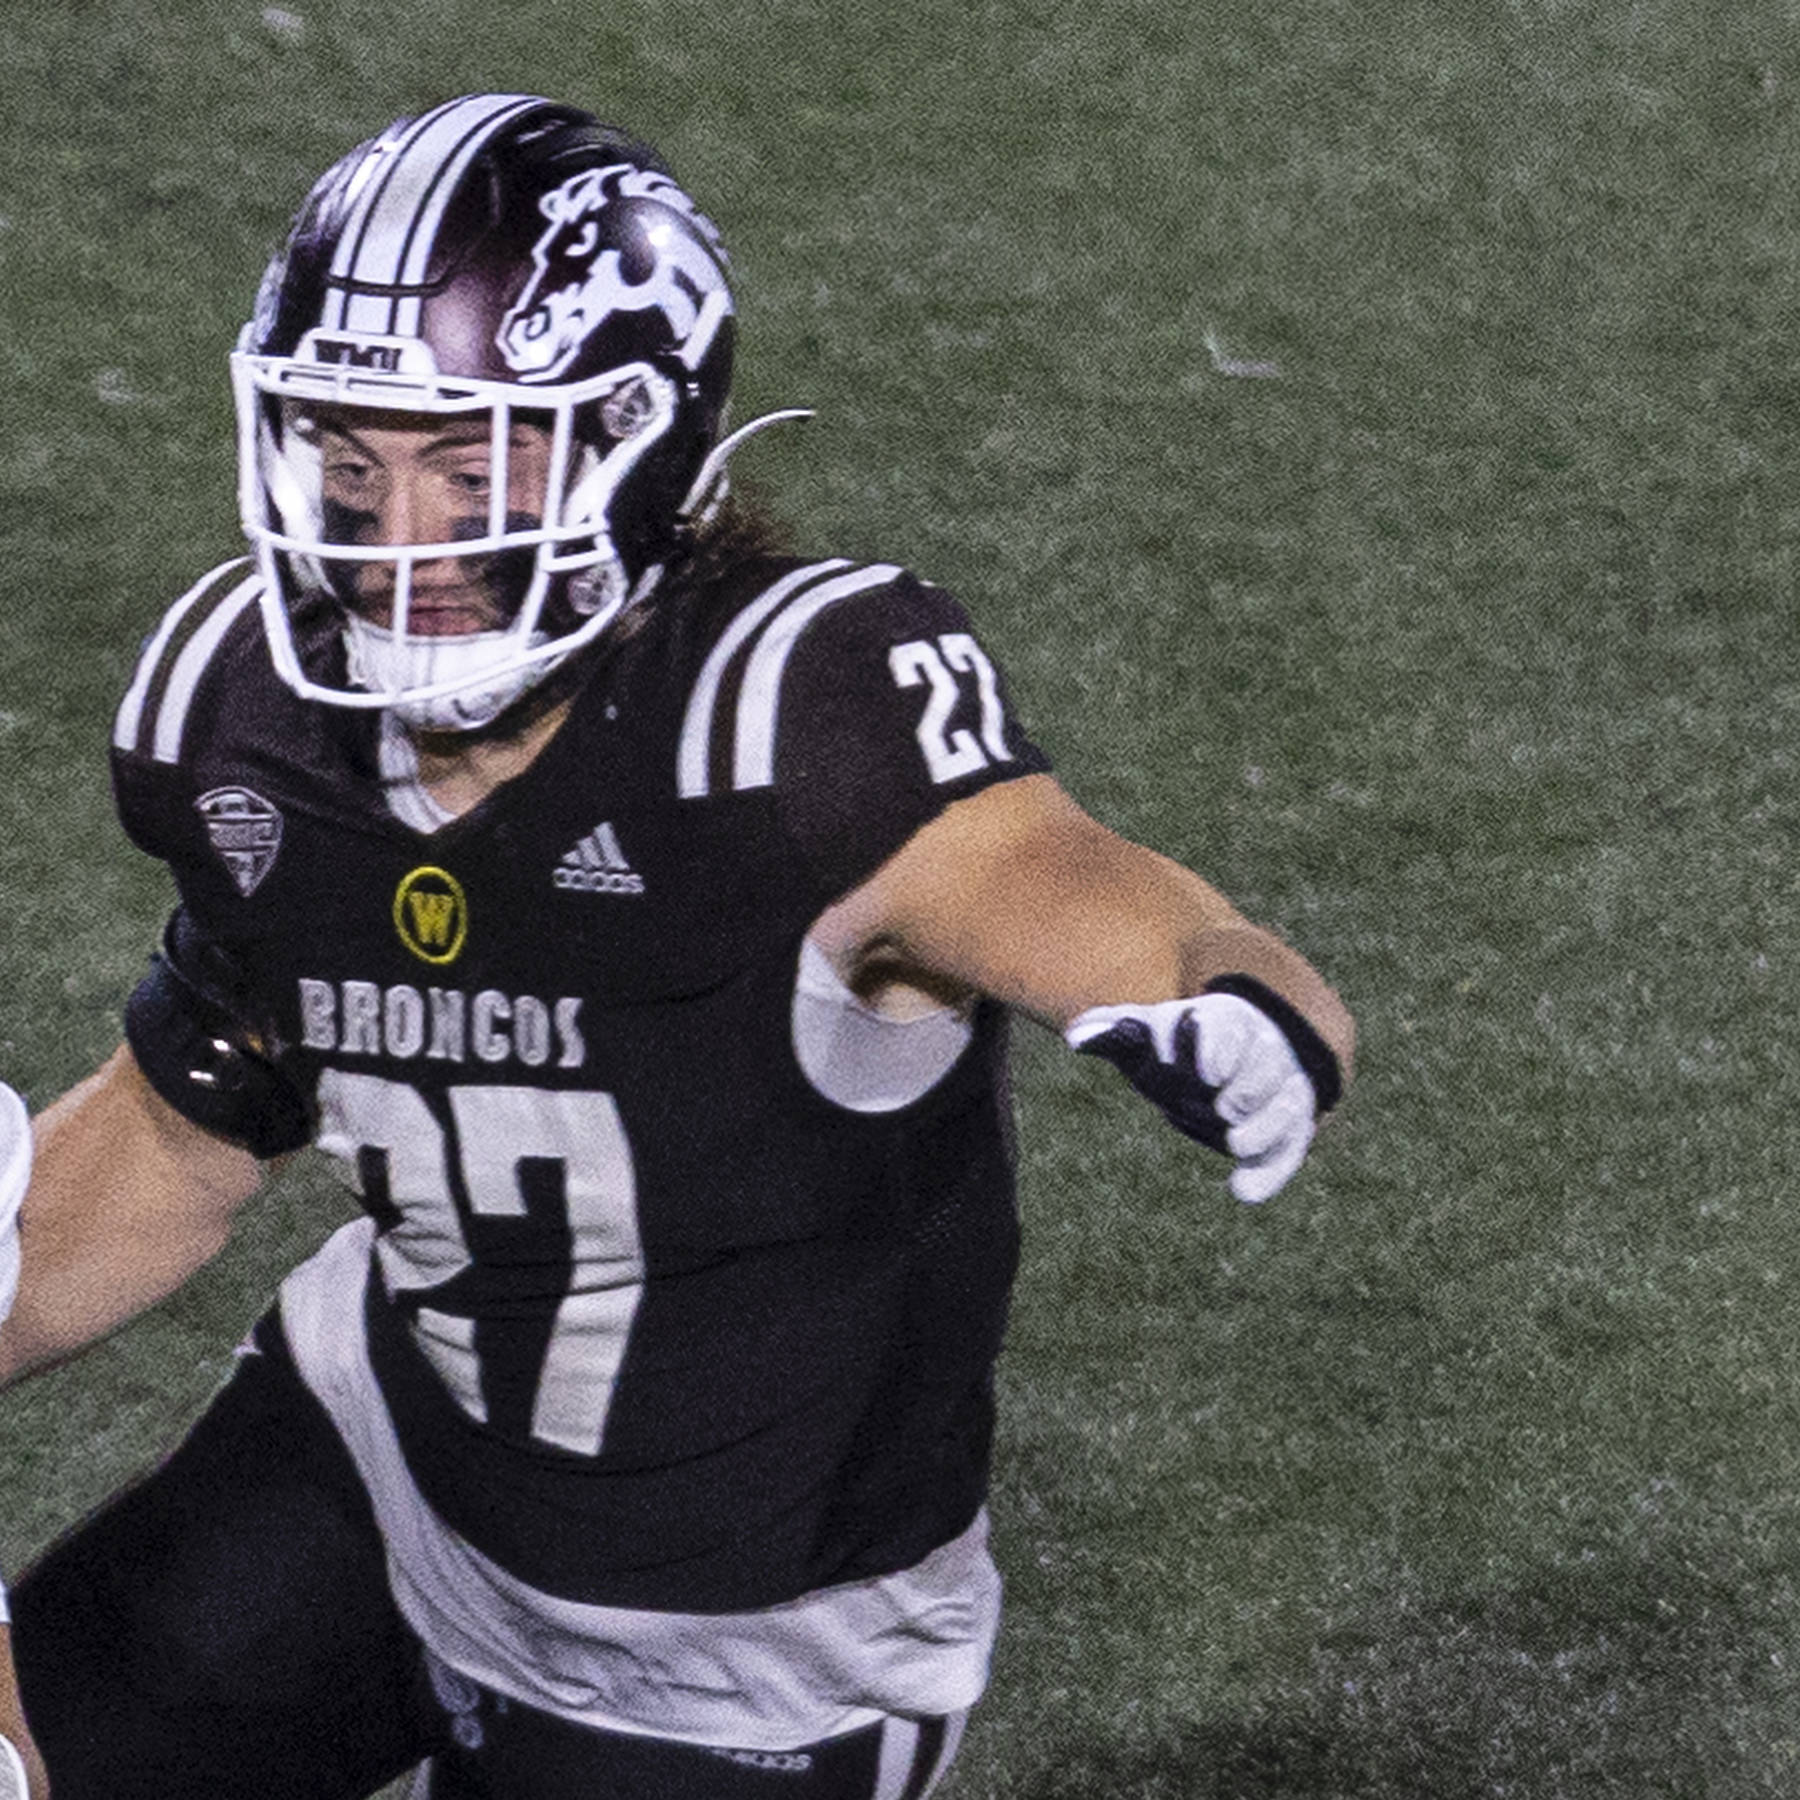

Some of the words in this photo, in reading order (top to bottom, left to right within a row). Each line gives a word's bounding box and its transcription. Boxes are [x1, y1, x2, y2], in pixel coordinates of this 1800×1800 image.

[312, 339, 403, 372] WMU
[887, 633, 1015, 785] 27
[552, 867, 645, 894] adidas
[298, 978, 587, 1069] BRONCOS
[315, 1067, 647, 1458] 27
